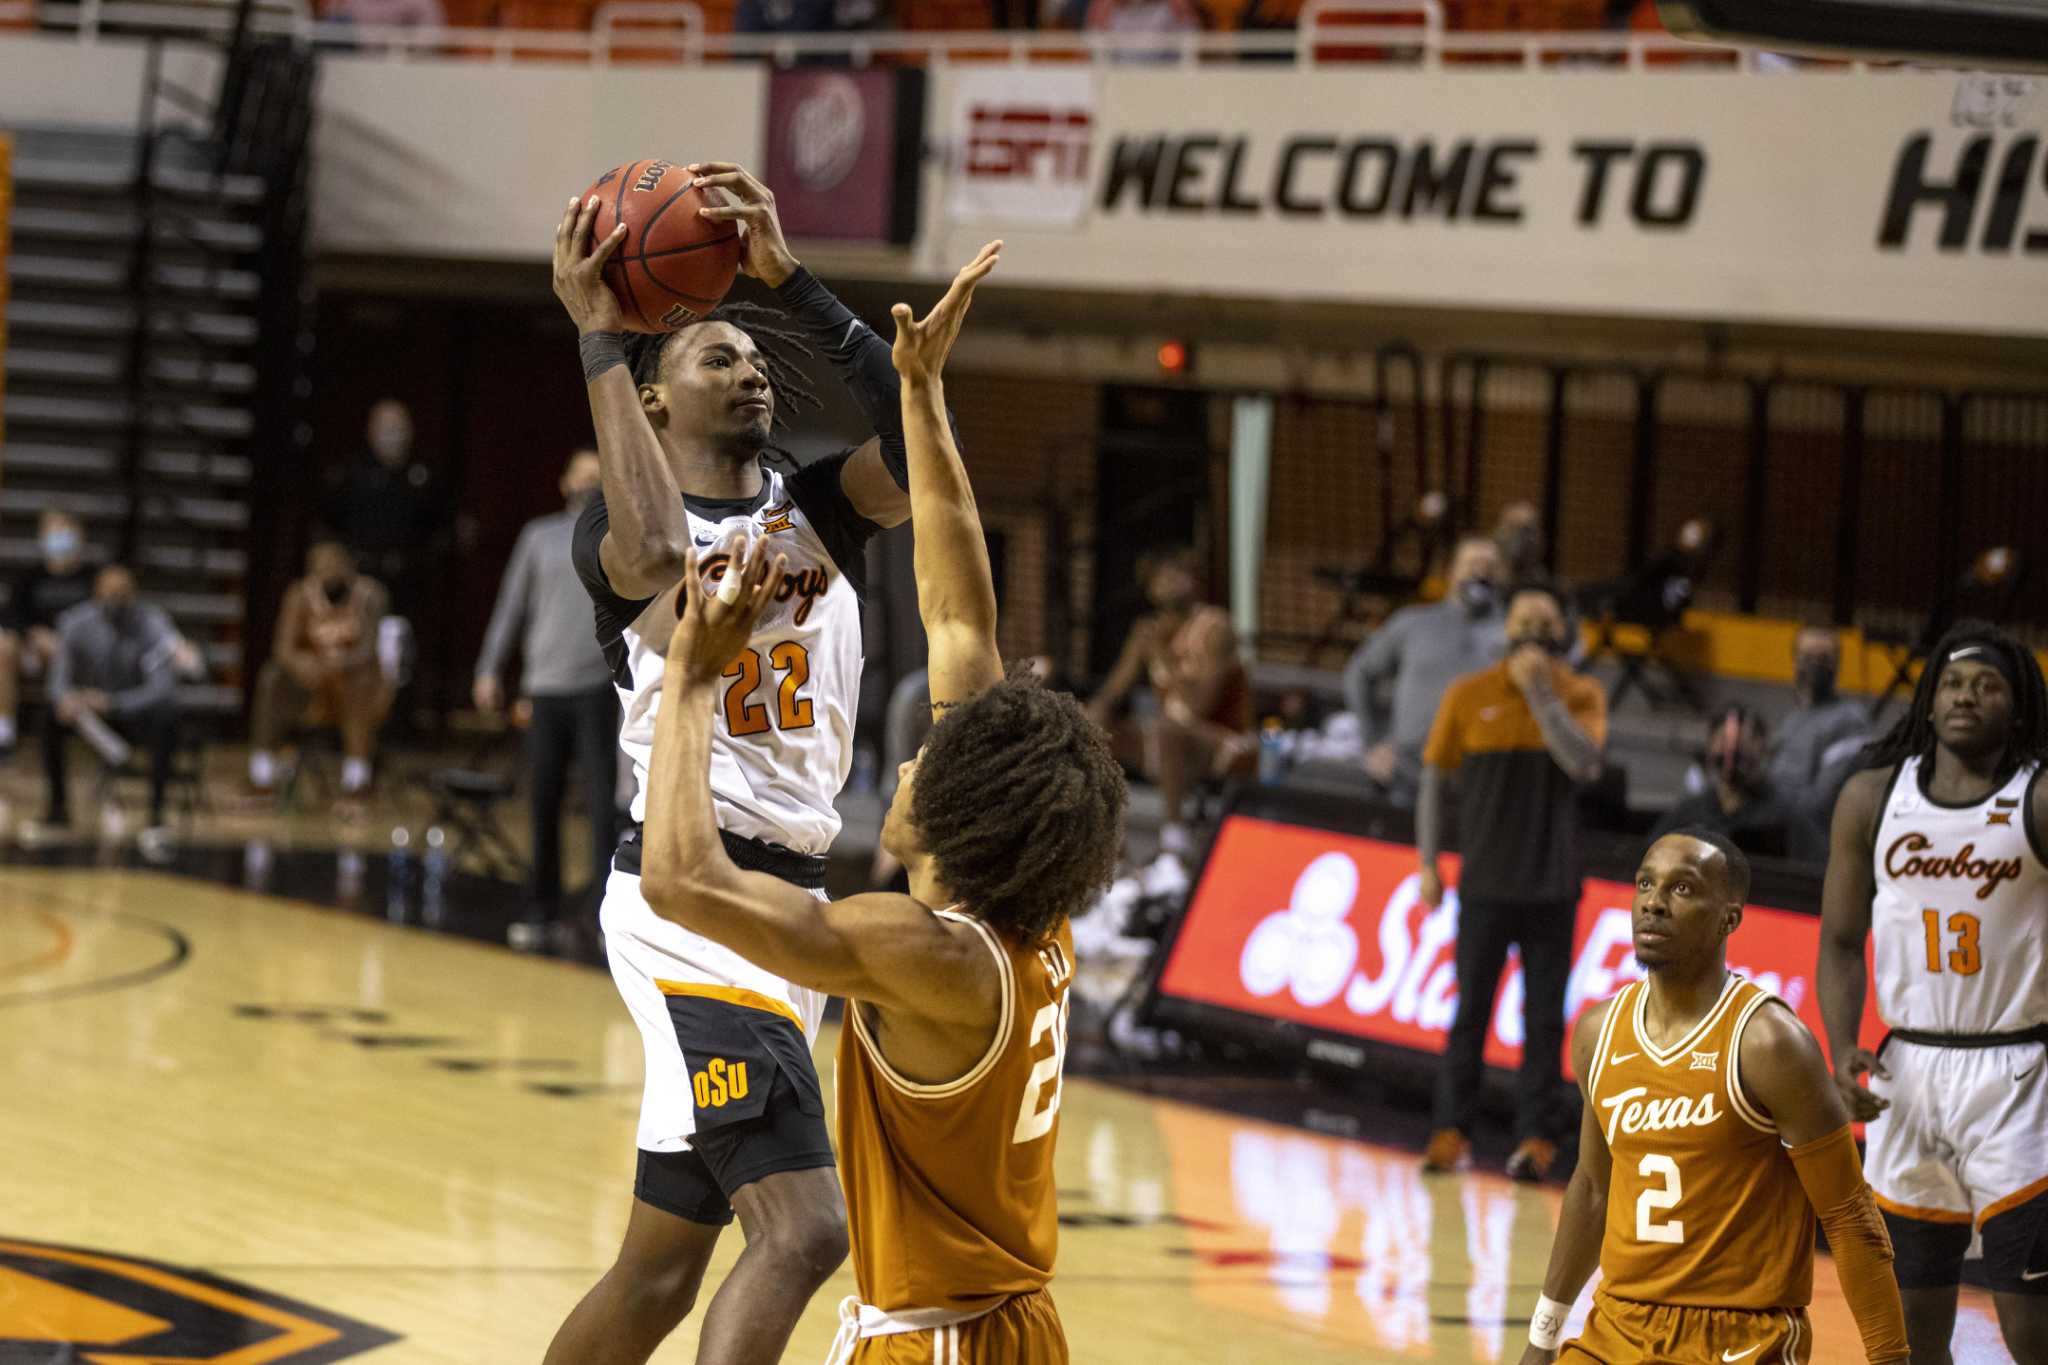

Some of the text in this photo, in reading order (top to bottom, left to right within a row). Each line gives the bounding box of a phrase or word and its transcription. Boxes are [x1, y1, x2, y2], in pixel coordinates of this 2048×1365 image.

[1101, 133, 1538, 226] WELCOME
[1570, 139, 1707, 230] TO
[721, 640, 816, 738] 22
[1885, 832, 2022, 900] Cowboys
[1922, 908, 1983, 977] 13
[1601, 1086, 1724, 1146] Texas
[1635, 1152, 1685, 1244] 2
